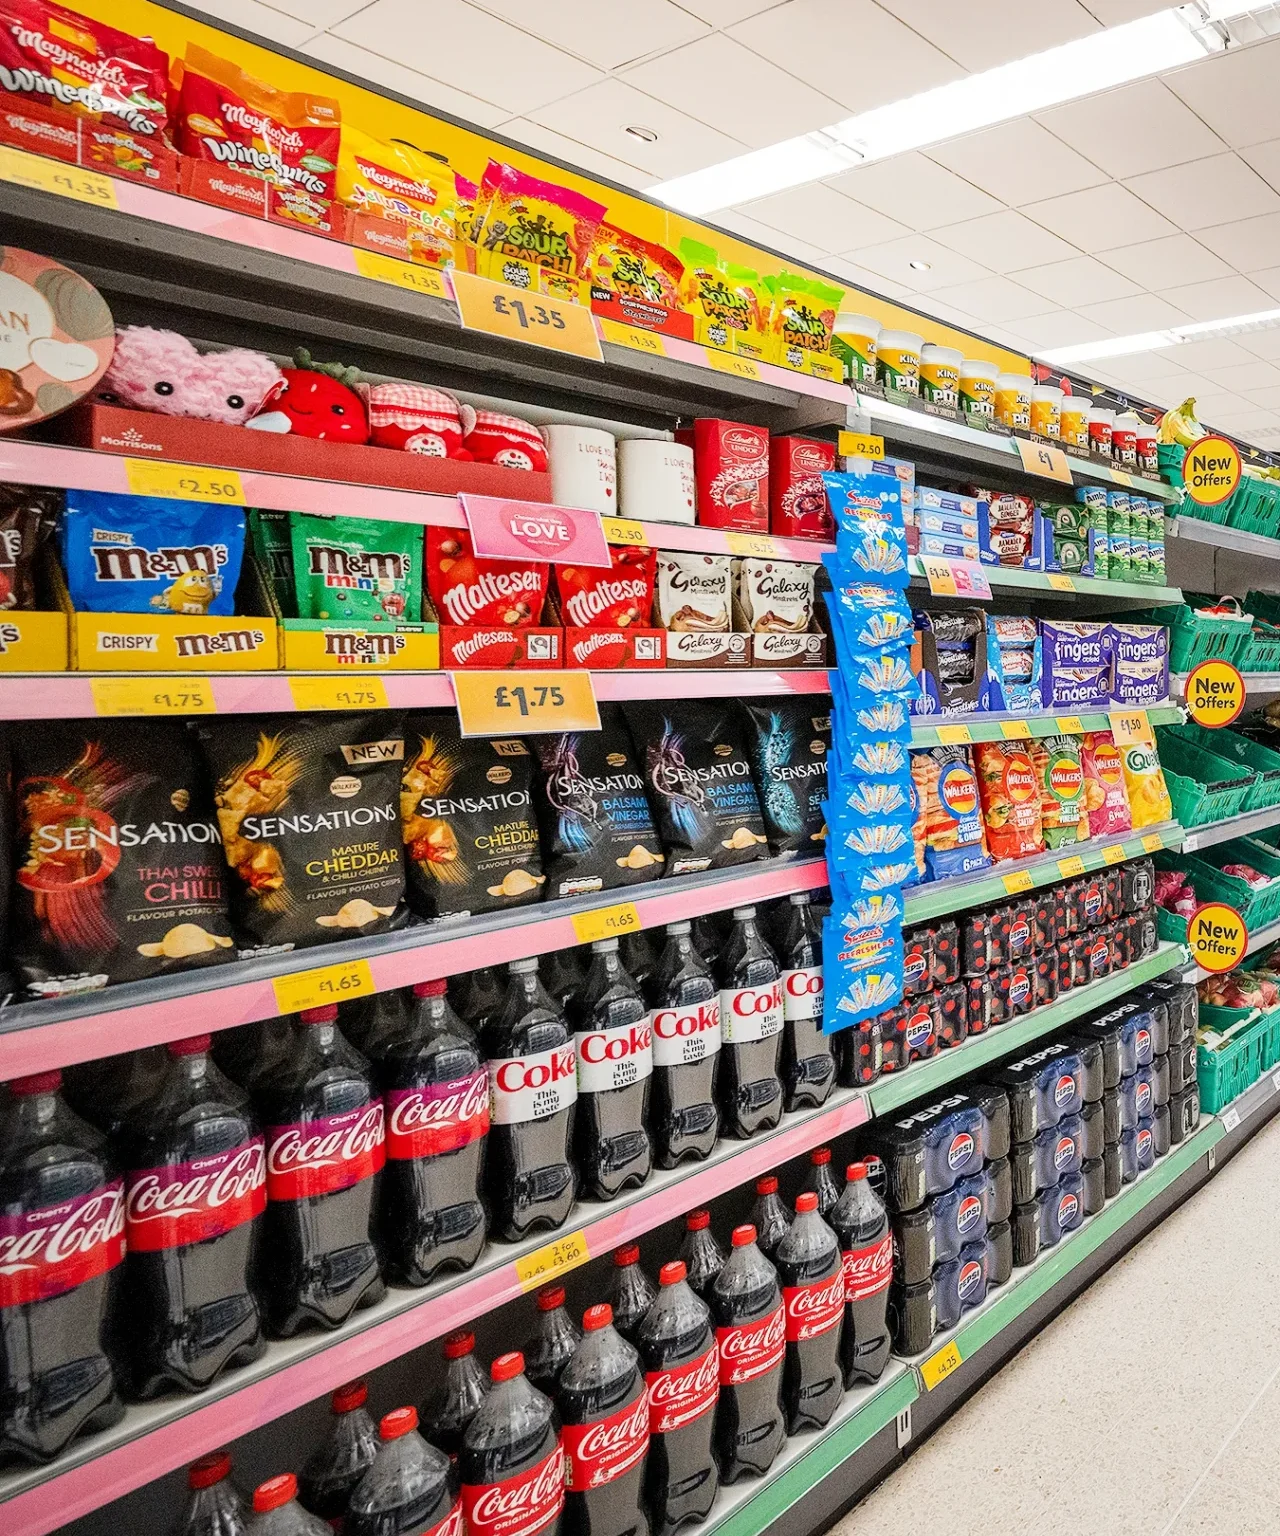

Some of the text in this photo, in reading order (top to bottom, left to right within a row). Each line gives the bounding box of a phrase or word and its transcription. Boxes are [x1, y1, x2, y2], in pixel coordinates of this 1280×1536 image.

[11, 25, 128, 86] Maynards
[6, 115, 77, 145] Maynards
[221, 102, 303, 147] Maynards
[53, 174, 111, 200] £1.35
[208, 178, 266, 201] Maynards
[357, 163, 437, 199] Maynards
[507, 226, 570, 259] SOUR
[500, 244, 573, 274] PATCH
[503, 265, 529, 278] SOUR
[403, 271, 440, 291] £1.35
[592, 291, 611, 300] NEW
[702, 289, 749, 311] SOUR
[493, 295, 566, 329] £1.35
[701, 298, 753, 325] PATCH
[787, 318, 825, 336] SOUR
[630, 335, 657, 349] £1.35
[784, 330, 830, 351] PATCH
[733, 363, 756, 376] £1.35
[100, 436, 163, 451] Morrisons
[731, 432, 756, 445] Lindt
[731, 444, 759, 454] LINDOR
[857, 443, 881, 455] £2.50
[1037, 450, 1054, 472] £1
[1193, 456, 1232, 472] New
[180, 478, 237, 497] £2.50
[1192, 473, 1232, 487] Offers
[95, 531, 130, 543] CRISPY
[510, 519, 571, 541] LOVE
[610, 527, 643, 540] £2.50
[929, 567, 950, 579] £1.25
[670, 570, 726, 594] Galaxy
[757, 576, 811, 600] Galaxy
[102, 635, 153, 649] CRISPY
[452, 631, 515, 664] Maltesers
[573, 632, 626, 663] Maltesers
[678, 633, 725, 651] Galaxy
[763, 633, 802, 651] Galaxy
[1054, 641, 1101, 662] fingers
[1118, 641, 1157, 661] fingers
[1195, 677, 1235, 694] New
[154, 694, 204, 707] £1.75
[337, 692, 376, 704] £1.75
[494, 686, 565, 716] £1.75
[1195, 697, 1235, 709] Offers
[1121, 718, 1142, 735] £1.50
[351, 744, 397, 760] NEW
[1095, 758, 1121, 769] WALKERS
[1051, 772, 1082, 783] WALKERS
[331, 782, 361, 791] WALKERS
[944, 784, 976, 798] WALKERS
[607, 810, 650, 822] VINEGAR
[494, 820, 530, 834] MATURE
[958, 821, 981, 833] CHEESE
[331, 841, 380, 857] MATURE
[305, 848, 399, 876] CHEDDAR
[963, 859, 970, 871] 6
[137, 867, 179, 881] THAI
[322, 865, 390, 883] & CHILLI CHUTNEY
[144, 880, 221, 903] CHILLI
[306, 887, 347, 900] FLAVOUR
[349, 882, 380, 894] POTATO
[1085, 896, 1101, 907] PEPSI
[126, 906, 213, 922] FLAVOUR POTATO
[606, 913, 635, 928] £1.65
[1010, 929, 1029, 940] PEPSI
[1197, 919, 1239, 940] New
[1091, 949, 1108, 960] PEPSI
[1196, 940, 1237, 956] Offers
[320, 974, 362, 993] £1.65
[1010, 983, 1029, 995] PEPSI
[653, 1006, 720, 1039] Coke
[1092, 1003, 1140, 1027] PEPSI
[907, 1023, 931, 1038] PEPSI
[580, 1027, 651, 1065] Coke
[684, 1038, 704, 1048] This
[683, 1051, 706, 1061] taste
[1008, 1042, 1070, 1072] PEPSI
[496, 1049, 576, 1094] Coke
[613, 1068, 637, 1080] is my
[614, 1061, 636, 1072] This
[448, 1077, 474, 1090] Cherry
[614, 1075, 637, 1087] taste
[532, 1095, 560, 1110] is my
[535, 1088, 557, 1100] This
[534, 1104, 560, 1116] taste
[899, 1094, 970, 1130] PEPSI
[329, 1113, 360, 1126] Cherry
[950, 1143, 973, 1160] PEPSI
[1055, 1144, 1075, 1160] PEPSI
[191, 1154, 229, 1171] Cherry
[26, 1203, 73, 1223] Cherry
[958, 1205, 981, 1223] PEPSI
[553, 1240, 575, 1256] 2 for
[553, 1248, 580, 1266] £3.60
[958, 1270, 981, 1288] PEPSI
[804, 1308, 835, 1322] ORIGINAL
[737, 1347, 770, 1364] ORIGINAL
[937, 1355, 958, 1375] £4.25
[666, 1391, 703, 1411] ORIGINAL
[598, 1439, 635, 1464] ORIGINAL
[494, 1506, 540, 1531] ORIGINAL
